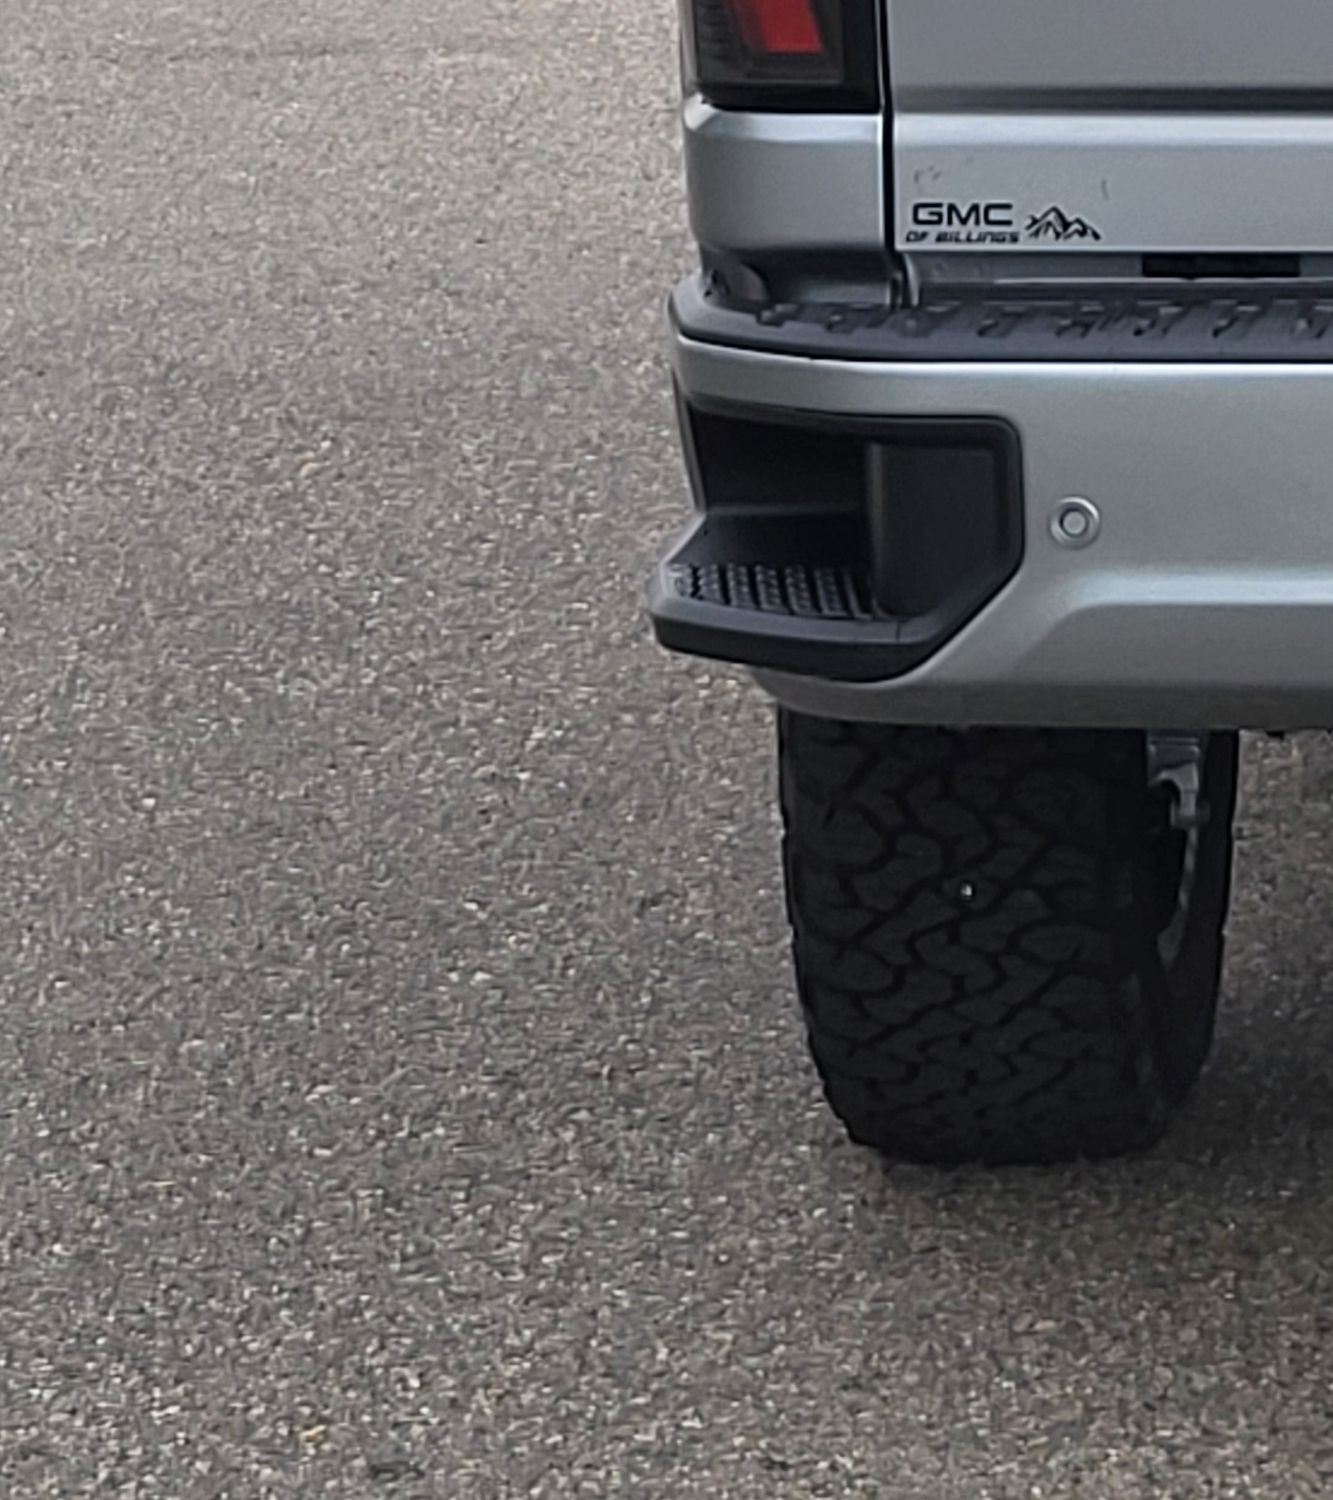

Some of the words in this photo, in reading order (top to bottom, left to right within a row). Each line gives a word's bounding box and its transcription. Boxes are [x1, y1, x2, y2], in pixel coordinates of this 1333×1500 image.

[912, 202, 1013, 226] GMC
[905, 230, 929, 243] OF
[934, 230, 1020, 243] BILLINGS
